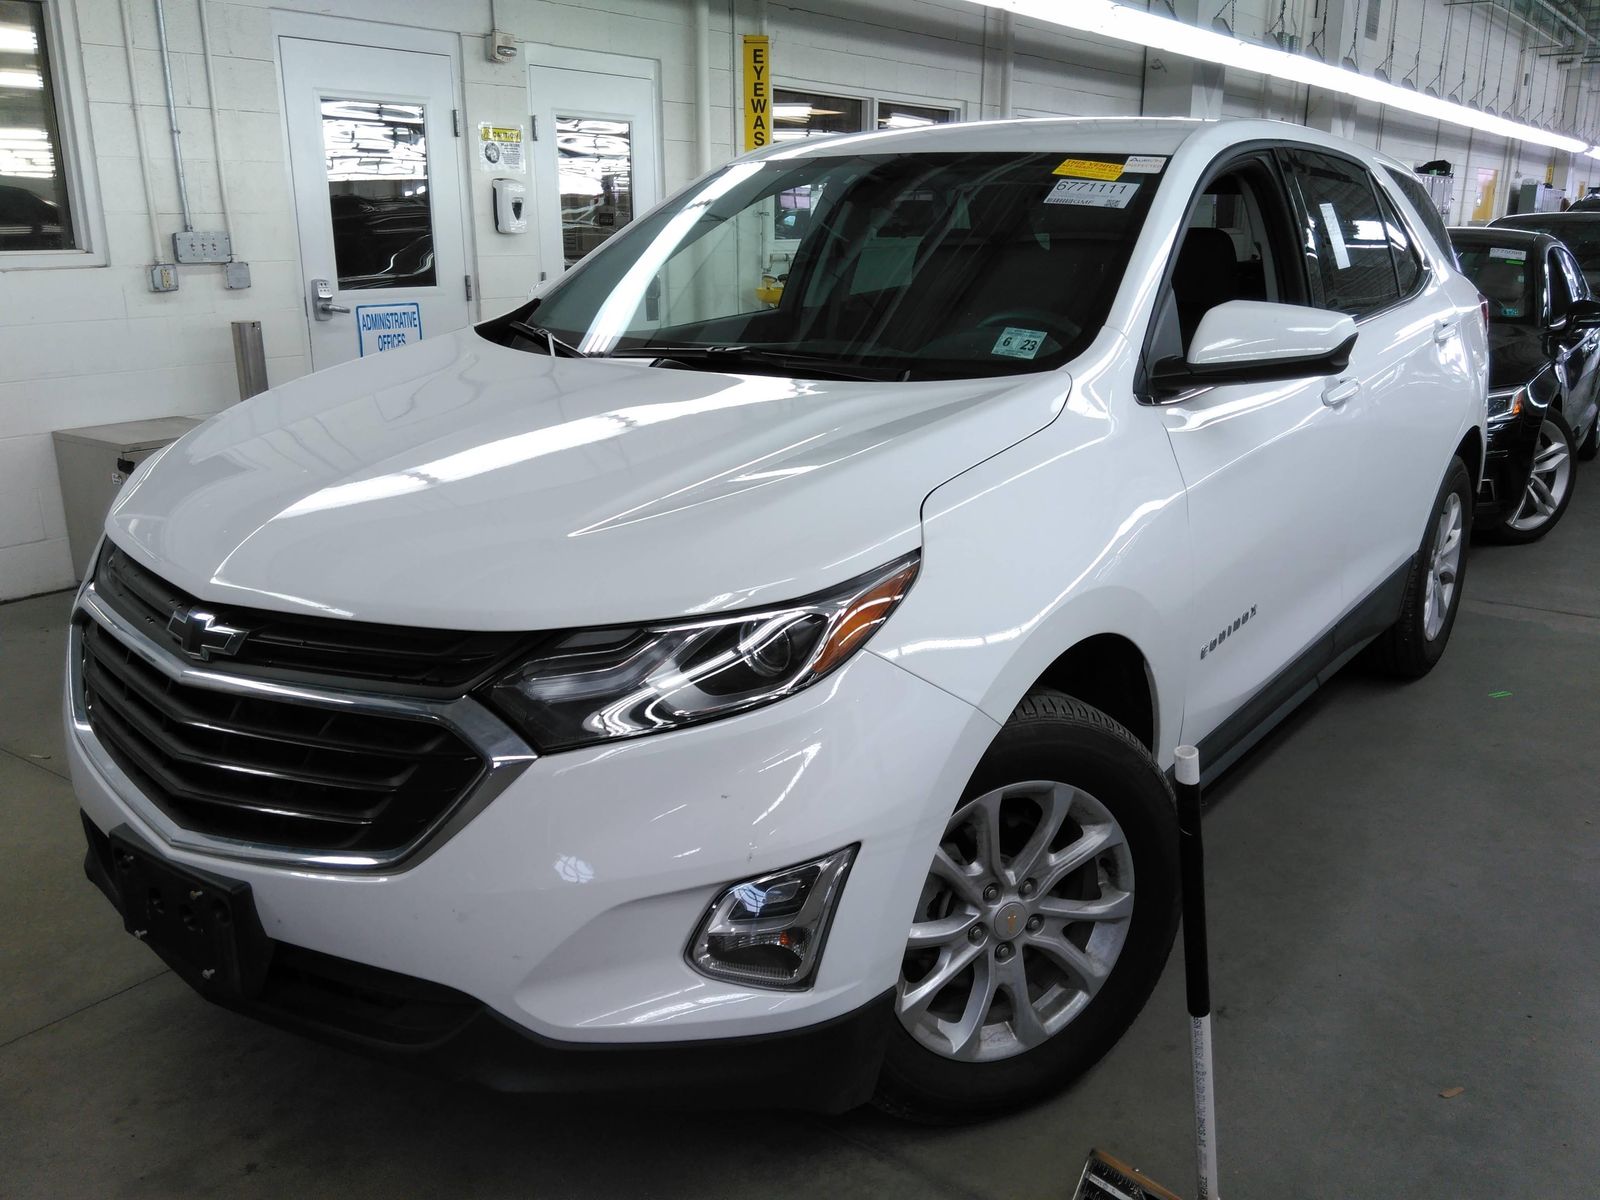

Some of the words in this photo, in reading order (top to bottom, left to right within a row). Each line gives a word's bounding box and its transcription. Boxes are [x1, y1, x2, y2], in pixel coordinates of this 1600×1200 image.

[751, 49, 767, 147] EYEWAS
[1057, 181, 1127, 194] 6771111
[362, 311, 418, 331] ADMINISTRATIVE
[378, 333, 406, 351] OFFICES
[1003, 337, 1012, 347] 6
[1019, 339, 1037, 351] 23
[1200, 604, 1257, 660] EQUINOX
